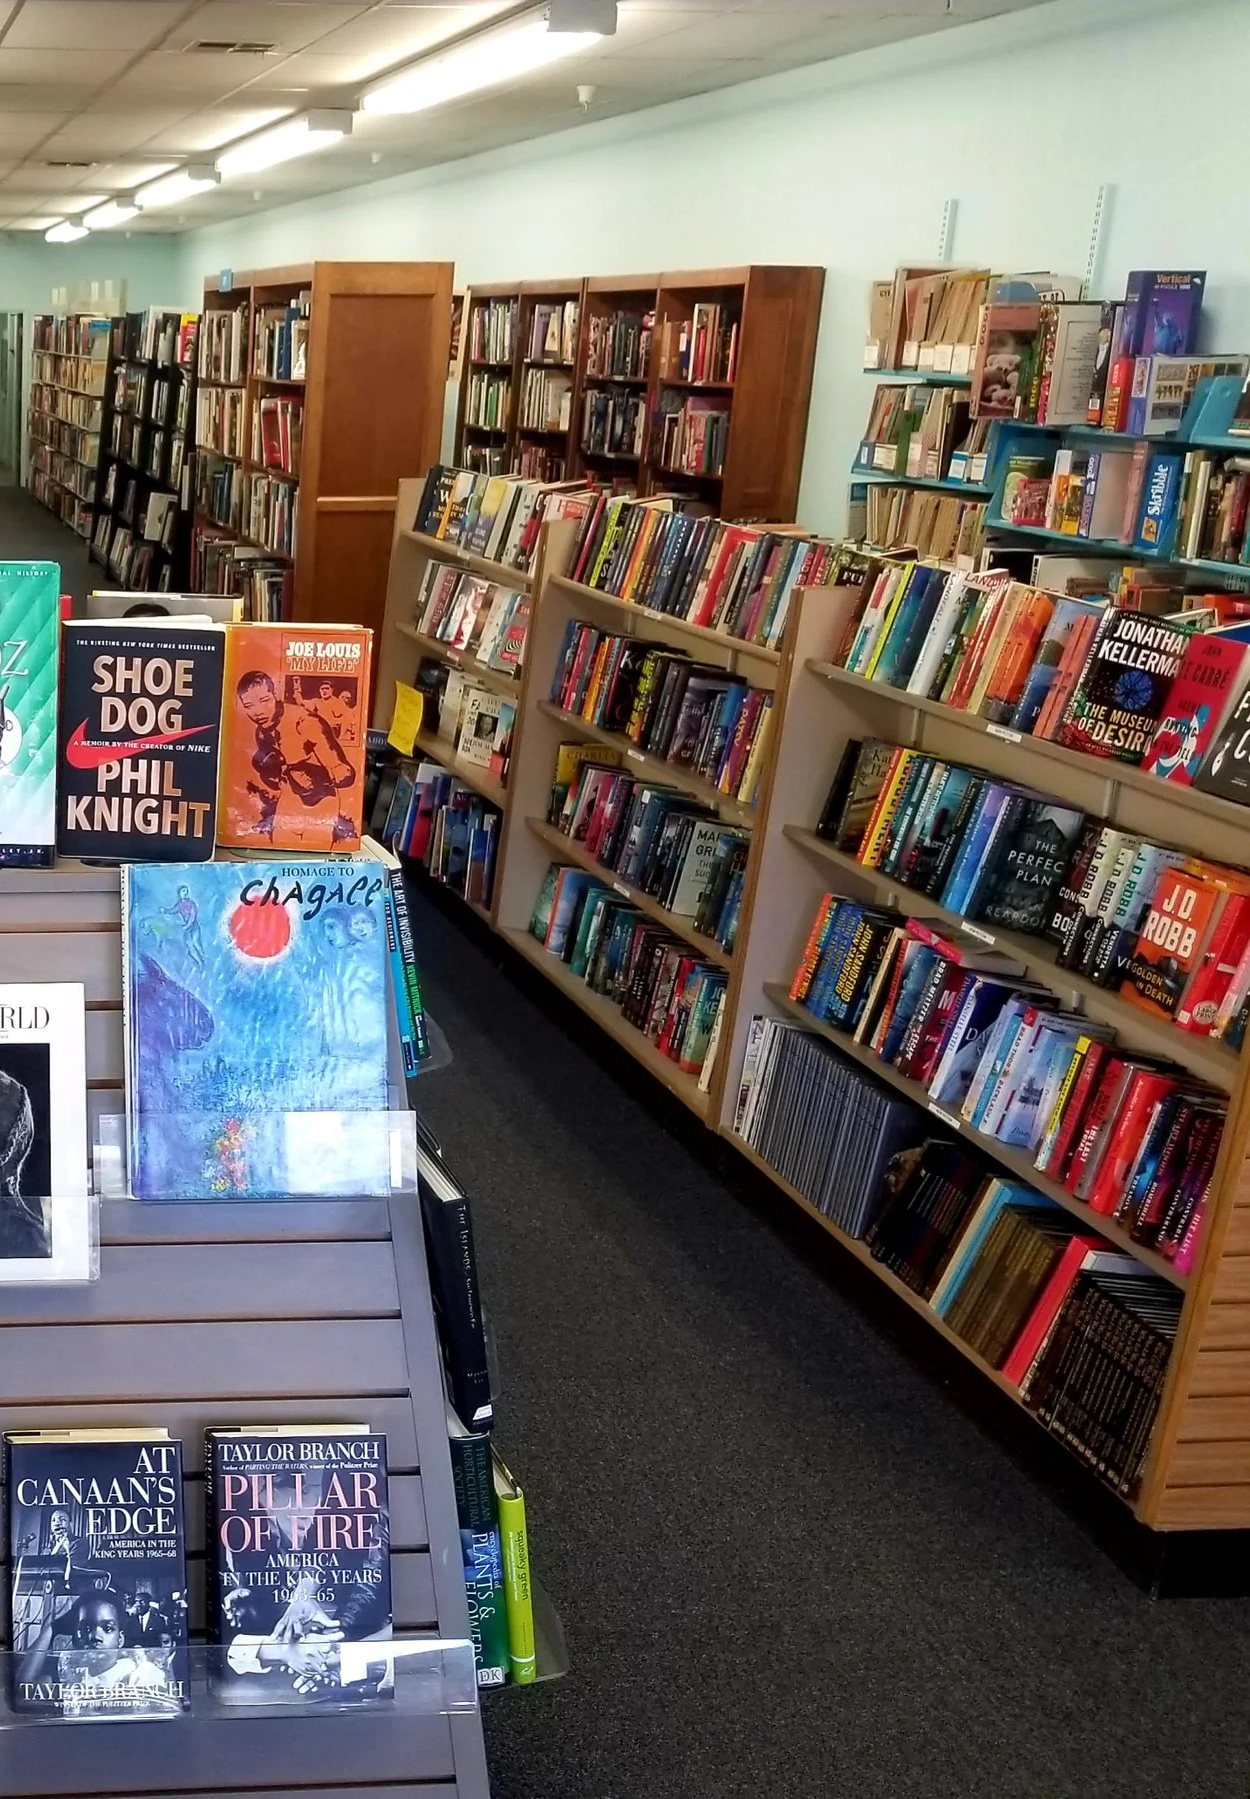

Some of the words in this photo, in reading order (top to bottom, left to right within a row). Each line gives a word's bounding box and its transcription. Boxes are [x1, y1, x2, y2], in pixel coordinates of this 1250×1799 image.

[1157, 274, 1191, 284] Vertical
[1147, 463, 1169, 516] Skribble
[177, 644, 216, 652] BESTSELLER
[286, 642, 314, 657] JOE
[316, 642, 361, 658] LOUIS
[1098, 638, 1180, 678] KELLERMA
[91, 655, 194, 697] SHOE
[101, 697, 183, 735] DOG
[1084, 702, 1108, 720] THE
[1078, 717, 1094, 734] OF
[140, 743, 174, 751] CREATOR
[187, 744, 211, 753] NIKE
[97, 759, 182, 796] PHIL
[67, 795, 211, 837] KNIGHT
[1034, 840, 1058, 854] THE
[282, 867, 335, 878] HOMAGE
[336, 866, 355, 876] TO
[1007, 850, 1065, 873] PERFEC
[391, 872, 402, 888] THE
[1015, 869, 1053, 887] PLAN
[1079, 869, 1098, 900] ROBB
[393, 888, 406, 905] ART
[1098, 880, 1117, 913] ROBB
[1116, 879, 1137, 918] ROBB
[1162, 884, 1198, 922] J.D.
[397, 904, 408, 917] OF
[398, 915, 416, 965] INVISIBILITY
[856, 924, 877, 955] JOHN
[1142, 910, 1198, 958] ROBB
[1099, 929, 1120, 970] VENDETTA
[406, 964, 418, 986] KEVIN
[837, 951, 869, 1002] SANDFORD
[931, 961, 948, 985] BRAD
[1131, 962, 1164, 987] GOLDEN
[916, 985, 939, 1023] MELTZER
[1144, 984, 1175, 1007] DEATH
[1013, 1026, 1027, 1048] BRAD
[1005, 1048, 1018, 1069] THOR
[1122, 1174, 1141, 1212] TREASON
[1188, 1213, 1202, 1233] HIT
[1179, 1232, 1195, 1256] LIST
[134, 1446, 176, 1475] AT
[218, 1443, 295, 1462] TAYLOR
[299, 1441, 380, 1462] BRANCH
[16, 1476, 177, 1507] CANAAN'S
[220, 1471, 382, 1512] PILLAR
[461, 1443, 480, 1529] HORTICULTURAL
[86, 1507, 177, 1536] EDGE
[220, 1515, 279, 1553] OF
[287, 1513, 383, 1552] FIRE
[94, 1549, 116, 1559] KING
[117, 1549, 145, 1559] YEARS
[108, 1539, 146, 1549] AMERICA
[148, 1539, 157, 1548] IN
[158, 1539, 177, 1548] THE
[488, 1531, 501, 1581] encyclopedia
[516, 1529, 527, 1572] squeaky
[266, 1552, 340, 1568] AMERICA
[472, 1532, 494, 1605] PLANTS
[223, 1571, 242, 1587] IN
[246, 1571, 281, 1587] THE
[286, 1569, 327, 1587] KING
[331, 1568, 382, 1584] YEARS
[518, 1571, 528, 1601] green
[479, 1606, 496, 1621] &
[479, 1668, 502, 1684] DK
